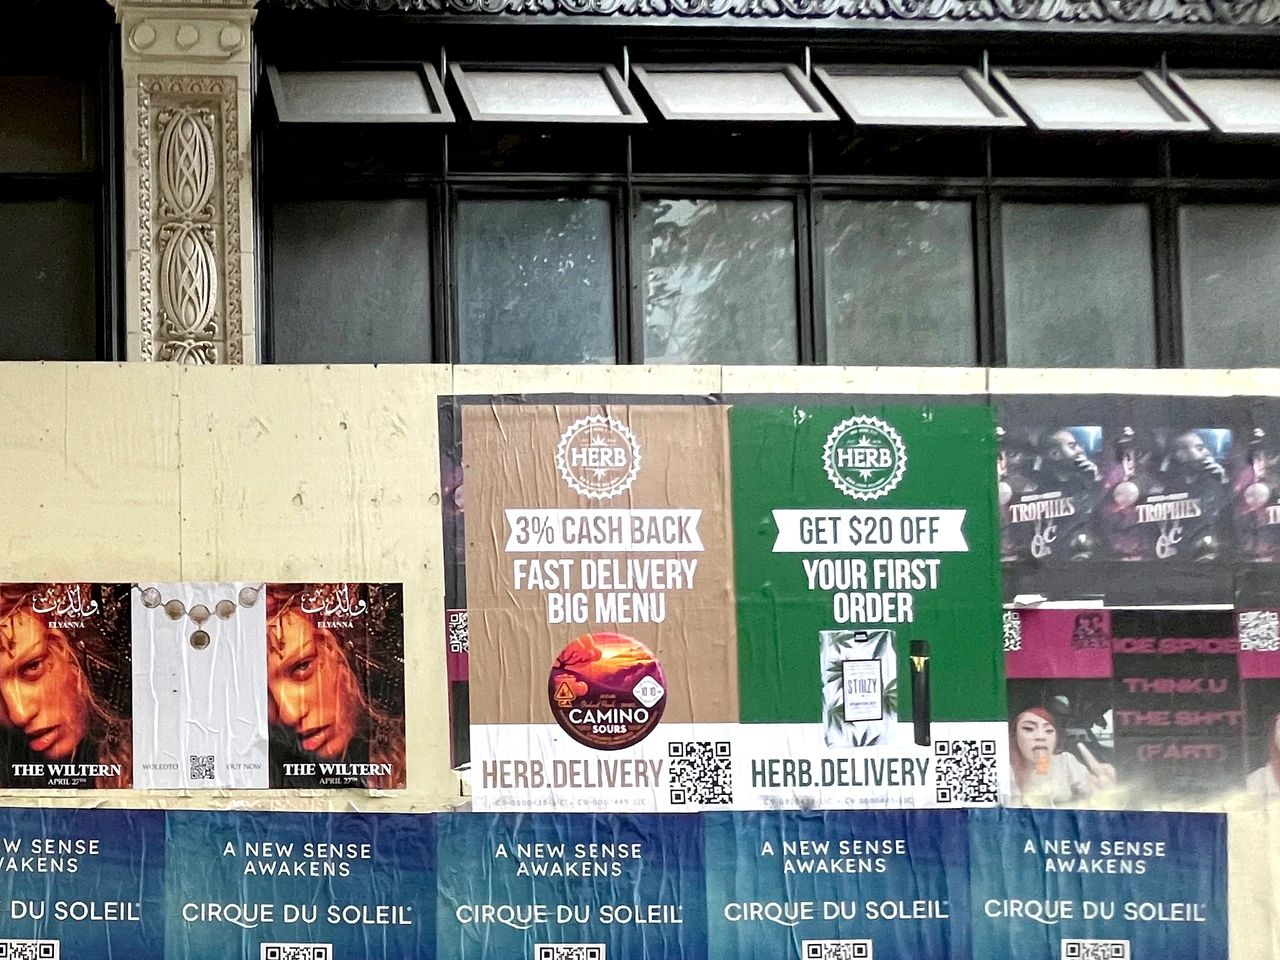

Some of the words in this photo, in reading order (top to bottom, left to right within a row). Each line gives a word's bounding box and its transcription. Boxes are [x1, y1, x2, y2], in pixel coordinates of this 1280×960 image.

[572, 448, 628, 467] HERB
[837, 449, 892, 467] HERB
[1009, 497, 1075, 522] TROPHIES
[1136, 499, 1201, 523] TROPHIES
[516, 516, 554, 544] 3%
[562, 516, 622, 544] CASH
[631, 516, 692, 544] BACK
[800, 517, 841, 544] GET
[849, 515, 892, 545] $20
[900, 517, 940, 544] OFF
[514, 559, 574, 590] FAST
[581, 559, 698, 590] DELIVERY
[802, 559, 868, 590] YOUR
[874, 559, 940, 590] FIRST
[548, 593, 588, 624] BIG
[595, 593, 666, 624] MENU
[833, 593, 913, 623] ORDER
[569, 708, 649, 724] CAMINO
[593, 725, 627, 734] SOURS
[12, 764, 45, 776] THE
[48, 764, 122, 776] WILTERN
[283, 764, 316, 776] THE
[318, 764, 392, 776] WILTERN
[482, 760, 663, 788] HERB.DELIVERY
[752, 758, 929, 787] HERB.DELIVERY
[48, 778, 70, 786] APRIL
[319, 777, 342, 785] APRIL
[32, 840, 99, 855] SENSE
[223, 842, 236, 856] A
[246, 843, 294, 857] NEW
[303, 844, 371, 858] SENSE
[495, 845, 508, 858] A
[518, 844, 565, 858] NEW
[575, 844, 641, 858] SENSE
[761, 842, 774, 856] A
[784, 841, 830, 856] NEW
[840, 840, 906, 855] SENSE
[1024, 840, 1035, 853] A
[1045, 840, 1091, 854] NEW
[1101, 841, 1166, 856] SENSE
[244, 861, 350, 876] AWAKENS
[517, 862, 622, 876] AWAKENS
[784, 859, 886, 873] AWAKENS
[1045, 859, 1146, 874] AWAKENS
[12, 900, 45, 919] DU
[55, 902, 140, 921] SOLEIL
[182, 904, 273, 928] CIRQUE
[284, 905, 317, 923] DU
[327, 906, 412, 924] SOLEIL
[456, 905, 547, 929] CIRQUE
[557, 905, 590, 923] DU
[599, 905, 683, 923] SOLEIL
[724, 902, 813, 926] CIRQUE
[824, 901, 856, 920] DU
[866, 901, 948, 920] SOLEIL
[985, 900, 1073, 924] CIRQUE
[1084, 901, 1114, 920] DU
[1124, 903, 1205, 922] SOLEIL
